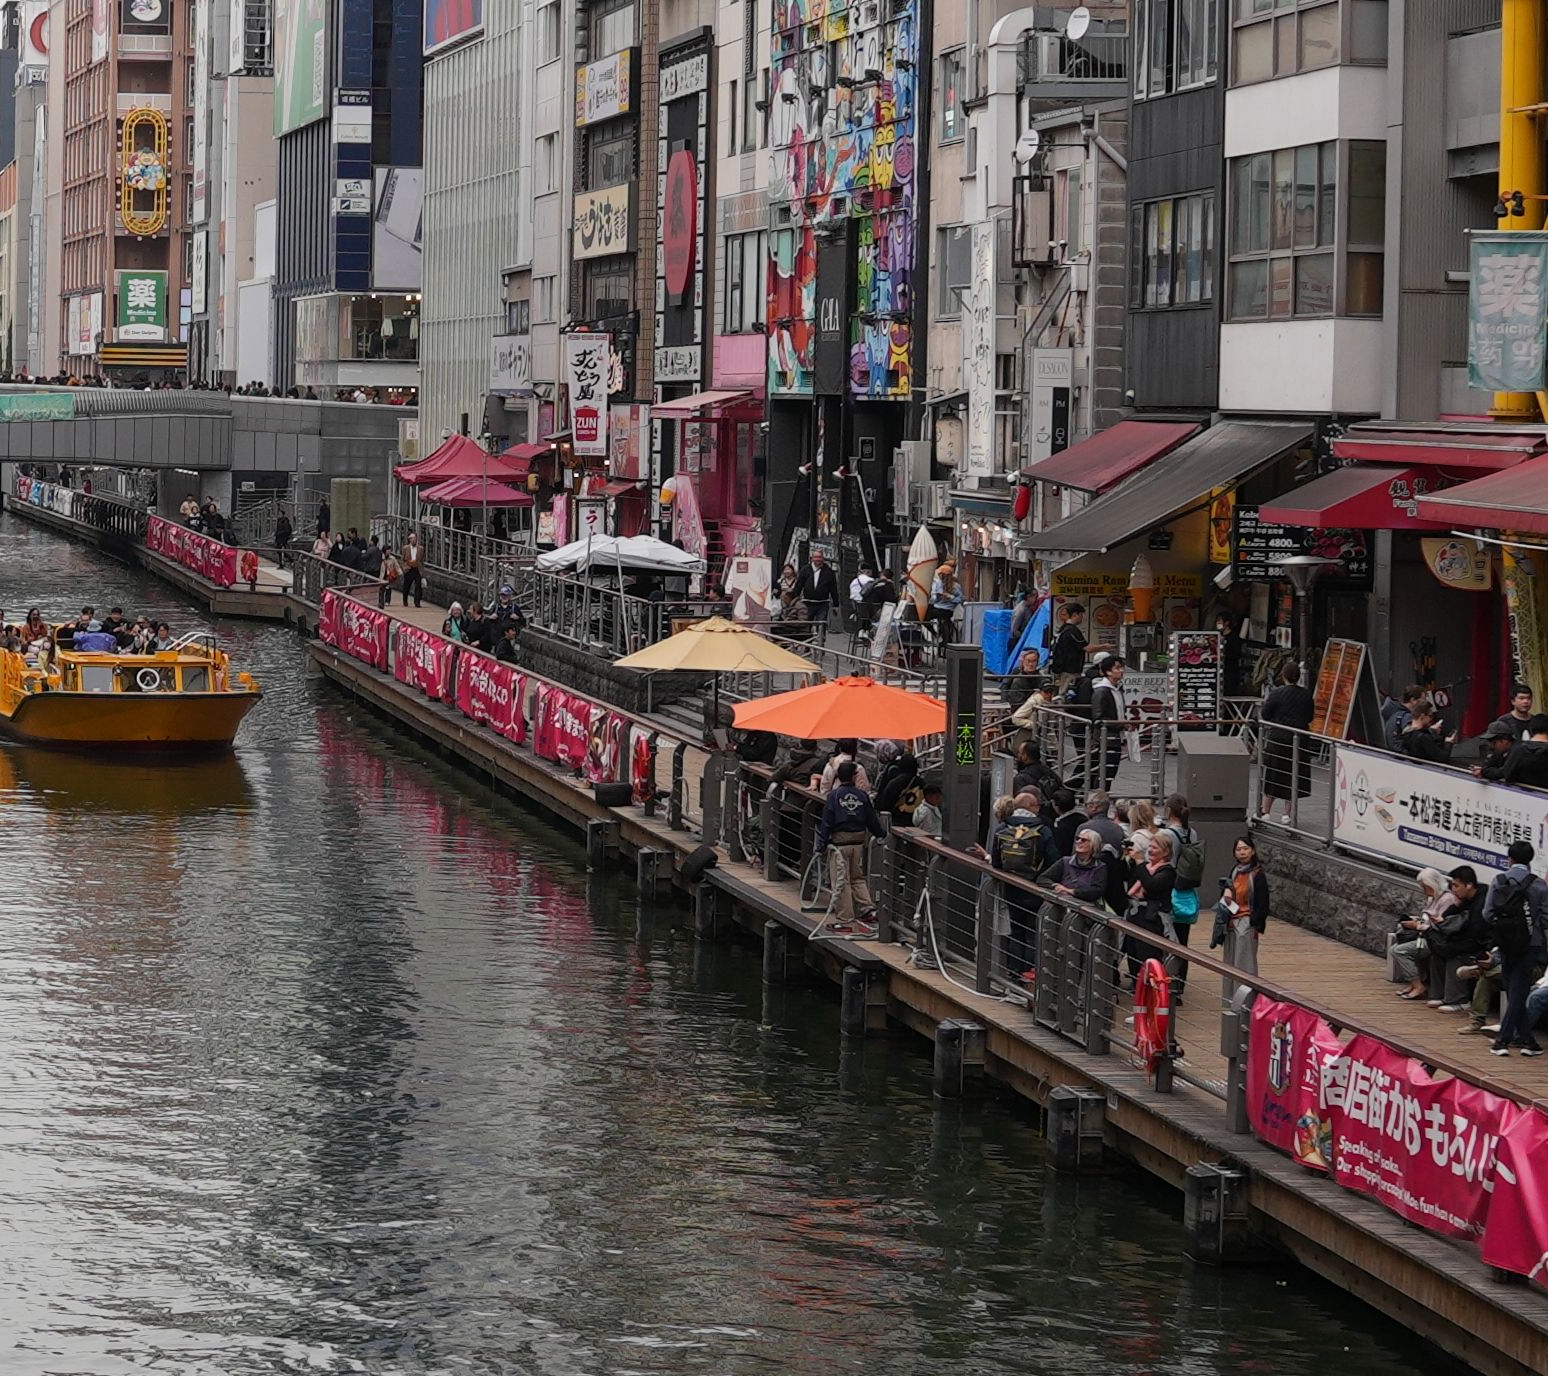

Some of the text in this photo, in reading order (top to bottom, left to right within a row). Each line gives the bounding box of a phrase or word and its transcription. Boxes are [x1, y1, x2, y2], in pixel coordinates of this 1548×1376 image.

[128, 279, 157, 308] 薬
[1479, 252, 1539, 320] 薬
[1475, 321, 1541, 336] Medicine
[577, 416, 597, 428] ZUN
[1056, 575, 1099, 586] Stamina
[1165, 576, 1197, 586] Menu
